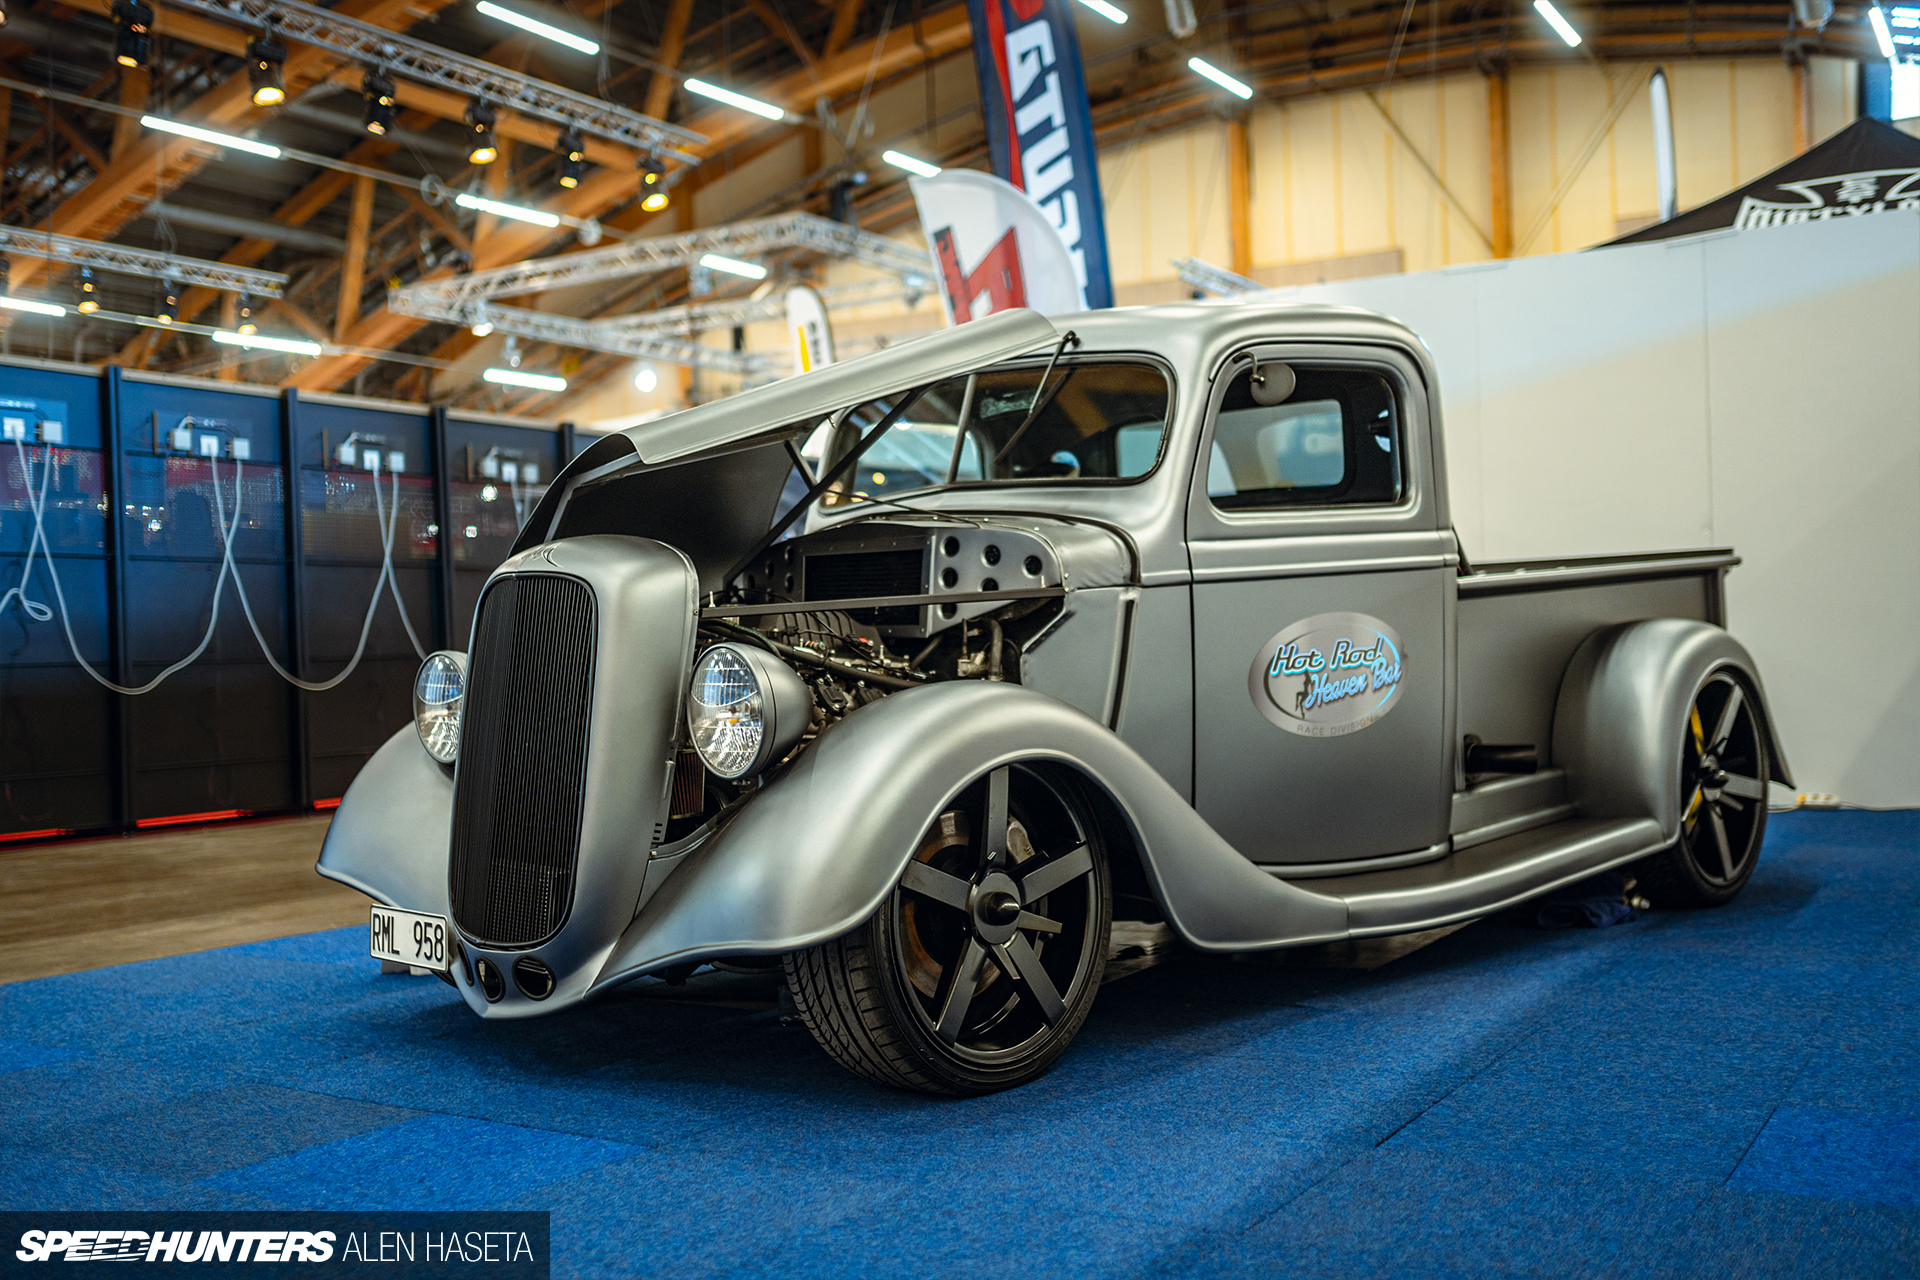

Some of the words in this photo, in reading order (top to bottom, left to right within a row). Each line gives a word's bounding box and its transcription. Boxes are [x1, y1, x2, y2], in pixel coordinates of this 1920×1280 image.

[1270, 644, 1326, 676] Hot
[1329, 636, 1384, 670] Rod
[1304, 672, 1368, 710] Heaven
[1370, 656, 1402, 692] Bar
[1296, 724, 1325, 737] RACE
[372, 913, 400, 955] RML
[413, 920, 444, 963] 958
